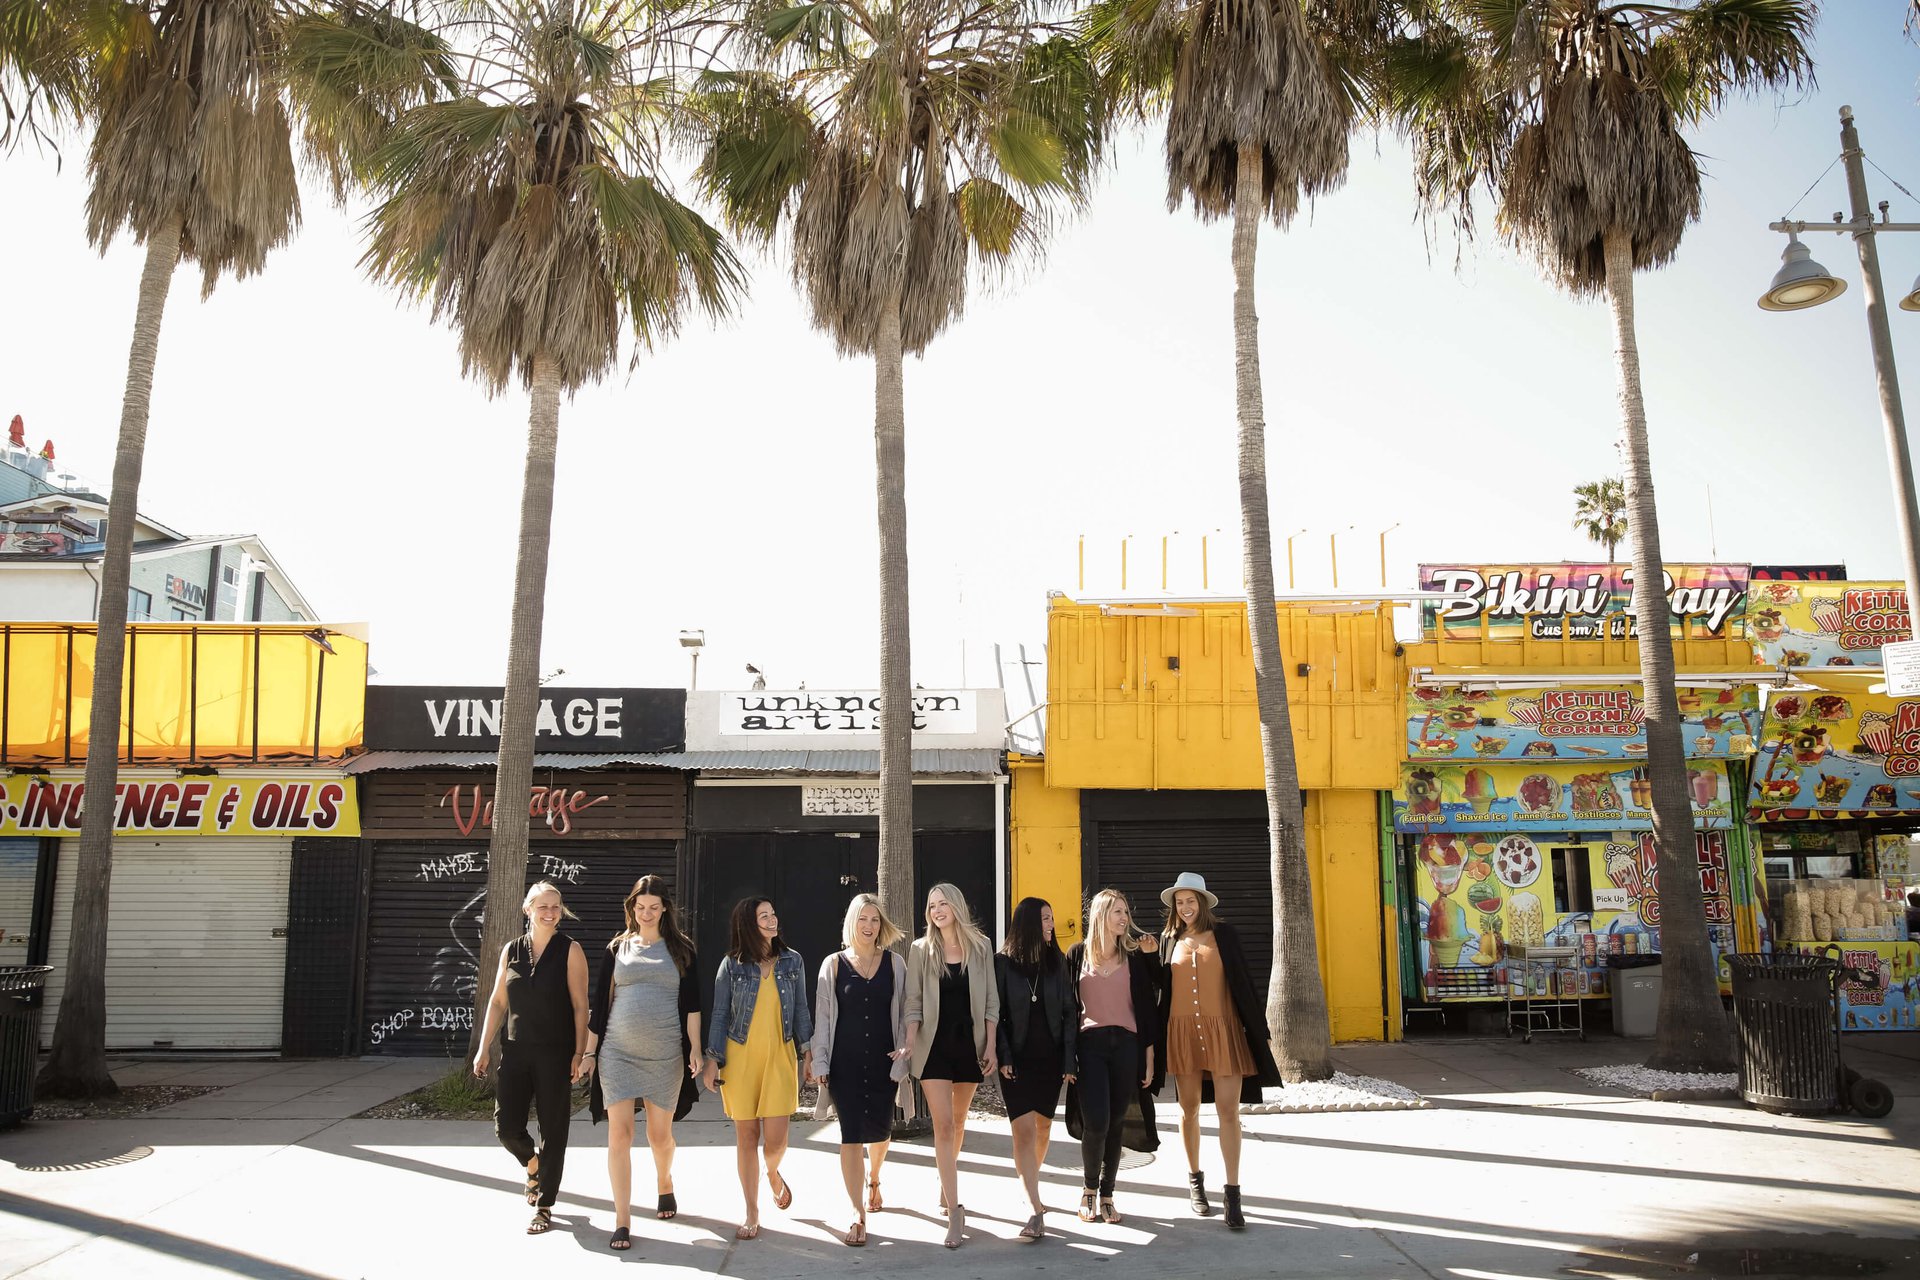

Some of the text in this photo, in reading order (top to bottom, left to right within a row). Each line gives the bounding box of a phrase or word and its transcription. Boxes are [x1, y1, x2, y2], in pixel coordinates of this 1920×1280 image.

[165, 573, 207, 607] ERWIN
[1431, 570, 1611, 619] Bikini
[1845, 590, 1909, 618] KETTL
[1532, 620, 1592, 637] Cusom
[1544, 691, 1631, 713] KETTLE
[424, 697, 623, 738] VINAGE
[1553, 709, 1622, 722] CORN
[1545, 724, 1631, 735] CORNER
[217, 786, 240, 830] &
[252, 783, 344, 829] OILS
[806, 799, 879, 814] artist
[1404, 814, 1426, 823] Fruit
[1427, 814, 1446, 824] Cup
[1456, 813, 1490, 822] Shaved
[1492, 813, 1507, 822] Ice
[1512, 812, 1544, 820] Funnel
[1545, 812, 1568, 820] Cake
[1572, 811, 1622, 820] Tostilocos
[1692, 810, 1726, 818] oothies
[1640, 831, 1725, 875] KLE
[417, 852, 482, 882] MAYBE
[540, 855, 588, 884] TIME
[1614, 895, 1625, 904] Up
[1646, 900, 1730, 920] CER
[1844, 951, 1879, 974] KETTLE
[1849, 992, 1882, 1003] CORNER
[371, 1009, 415, 1045] SHOP
